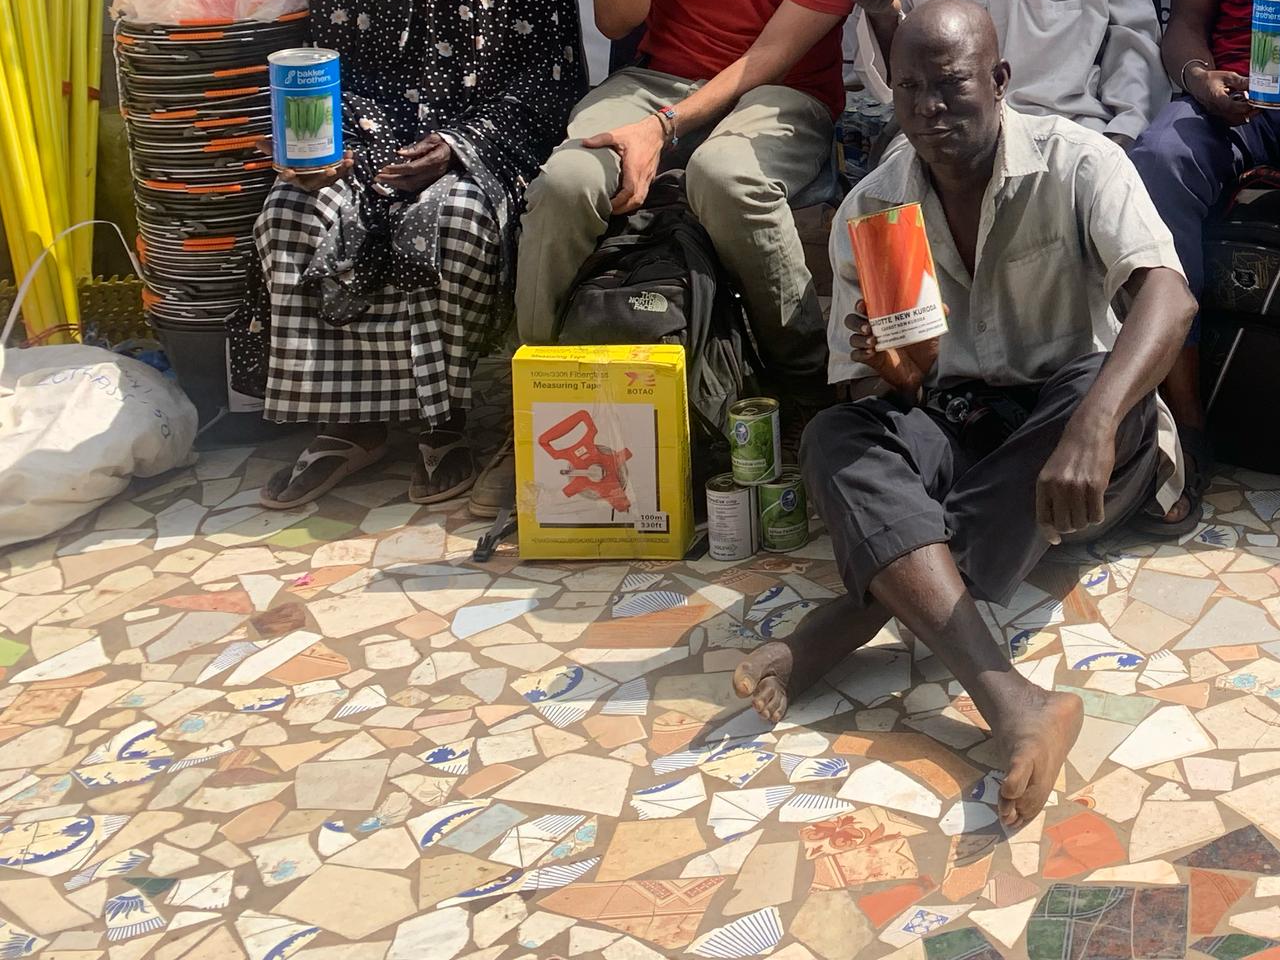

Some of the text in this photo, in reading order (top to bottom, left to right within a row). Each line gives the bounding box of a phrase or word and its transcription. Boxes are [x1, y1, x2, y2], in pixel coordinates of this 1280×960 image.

[297, 69, 326, 78] bakker
[634, 304, 653, 312] FACE
[894, 311, 911, 323] NEW
[533, 381, 578, 390] Measuring
